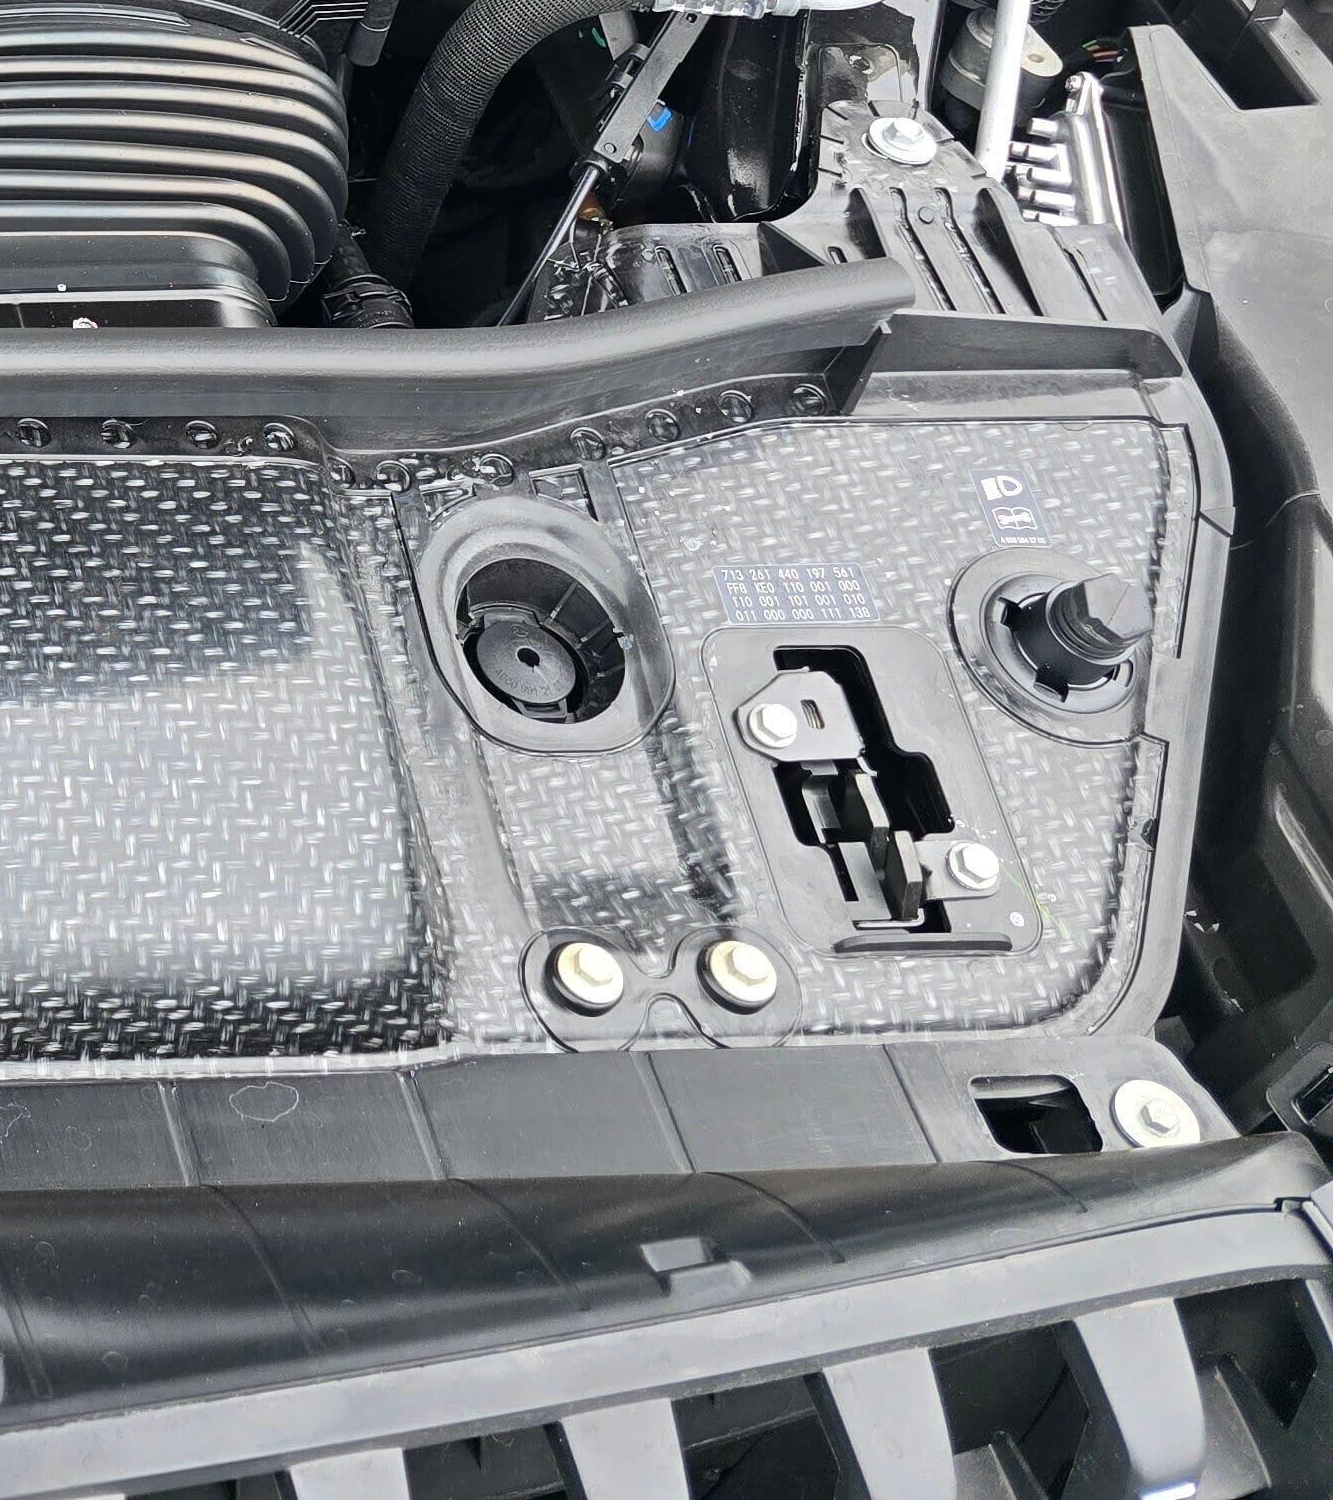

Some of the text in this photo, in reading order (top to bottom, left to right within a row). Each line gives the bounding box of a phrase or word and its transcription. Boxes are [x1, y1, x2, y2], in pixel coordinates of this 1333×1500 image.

[721, 566, 854, 581] 713 261 440 197 561
[783, 582, 804, 593] 110
[810, 581, 831, 592] 001
[838, 580, 860, 591] 000
[732, 593, 865, 608] 110 001 101 001 010
[736, 610, 757, 622] 011
[763, 609, 785, 621] 000
[792, 609, 814, 620] 000
[820, 608, 842, 619] 111
